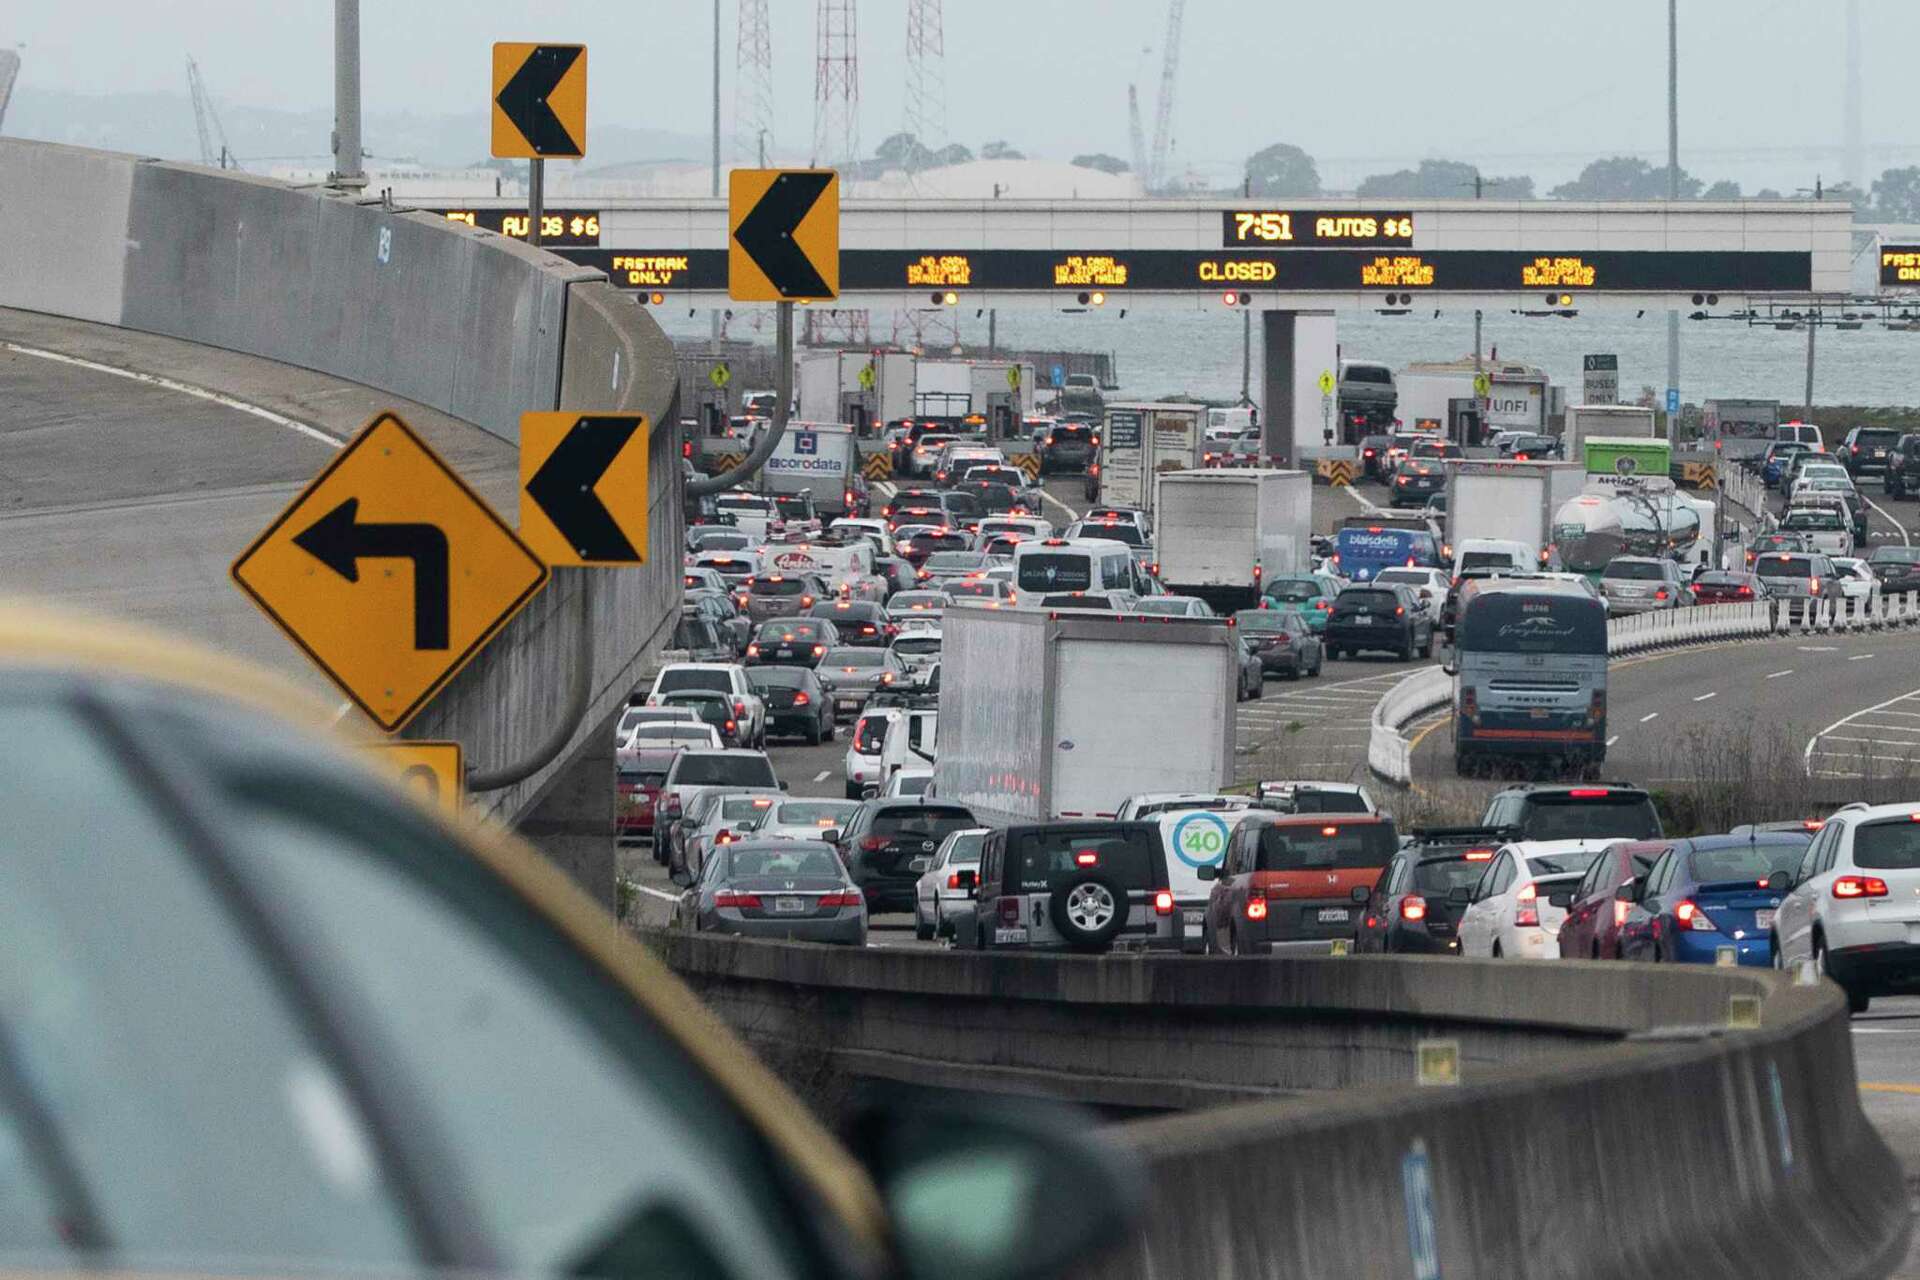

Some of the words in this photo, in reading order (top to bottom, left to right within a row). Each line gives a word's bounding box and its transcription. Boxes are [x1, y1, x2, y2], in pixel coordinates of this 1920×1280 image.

[503, 216, 563, 237] AUOS
[570, 216, 600, 237] $6
[1235, 213, 1293, 240] 7:51
[1316, 218, 1378, 237] AUTOS
[1384, 218, 1412, 237] $6
[613, 256, 689, 271] FASTRAK
[629, 271, 672, 285] ONLY
[1199, 262, 1276, 281] CLOSED
[780, 458, 842, 471] corodata
[1498, 623, 1576, 638] Greyhound
